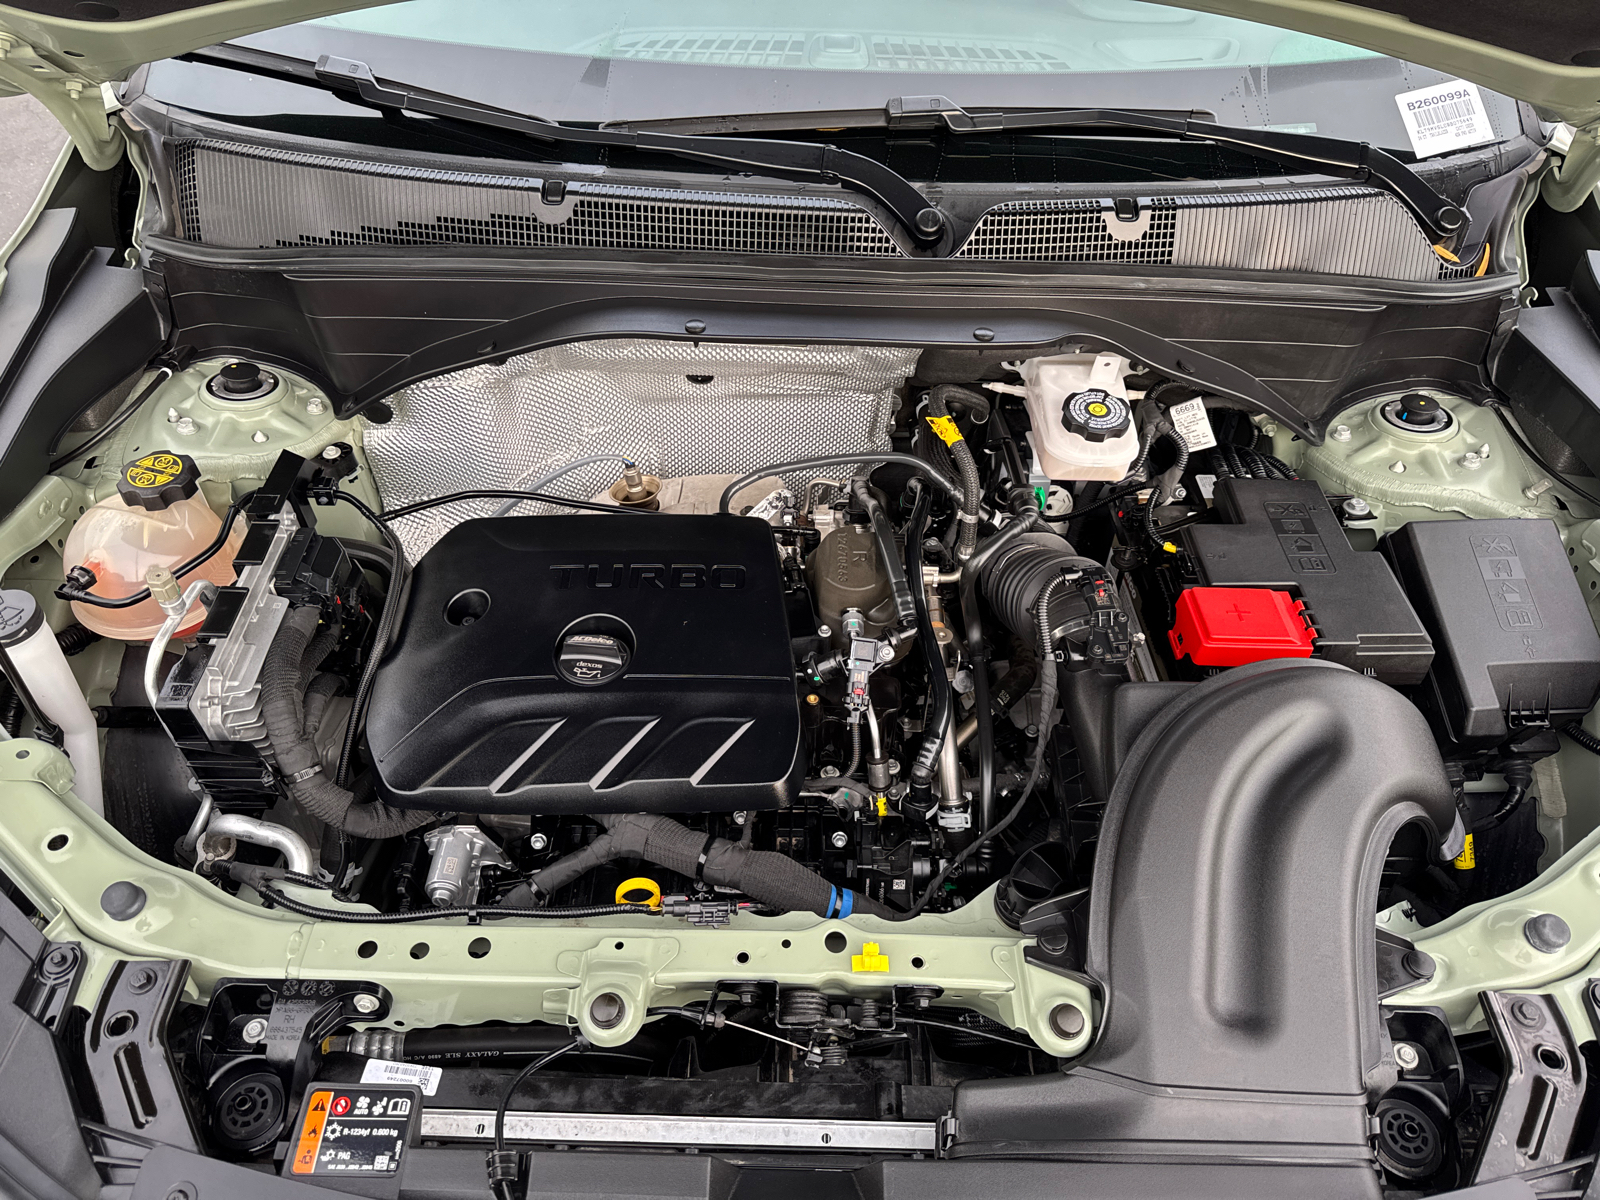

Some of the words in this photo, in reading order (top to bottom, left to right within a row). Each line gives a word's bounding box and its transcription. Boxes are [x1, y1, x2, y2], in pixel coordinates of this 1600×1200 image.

[1407, 89, 1471, 111] B260099A
[1175, 402, 1195, 415] 6669
[550, 563, 747, 589] TURBO
[569, 635, 614, 645] ACDelco
[576, 661, 603, 669] dexos
[283, 1015, 296, 1024] RH
[465, 1050, 500, 1058] GALAXY
[342, 1127, 371, 1137] R-1234yf
[390, 1128, 398, 1137] kg
[337, 1151, 351, 1160] PAG
